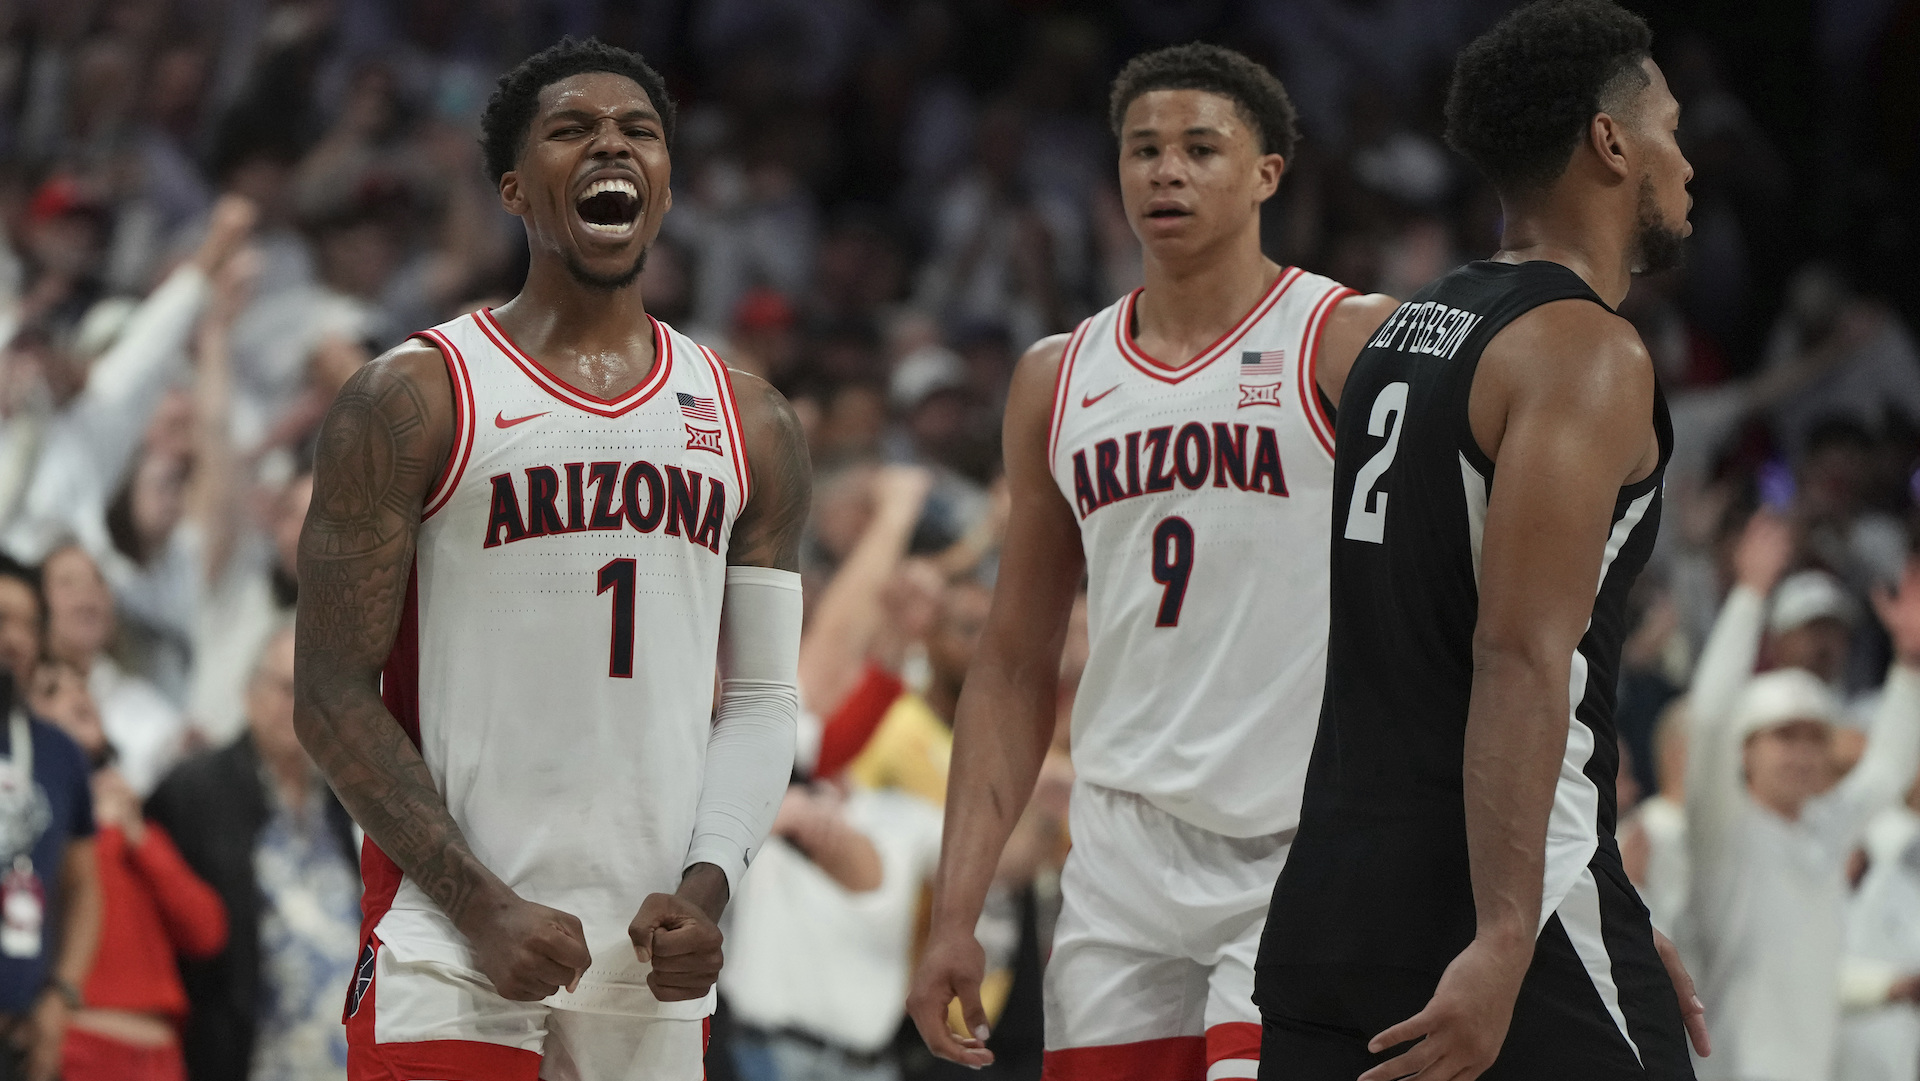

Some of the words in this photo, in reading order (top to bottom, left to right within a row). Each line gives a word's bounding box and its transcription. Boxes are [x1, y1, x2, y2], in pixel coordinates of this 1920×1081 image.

[1368, 301, 1484, 360] JEFFERSON
[483, 460, 726, 556] ARIZONA
[1073, 421, 1290, 521] ARIZONA
[1344, 381, 1410, 544] 2
[596, 557, 637, 679] 1
[1152, 515, 1195, 628] 9
